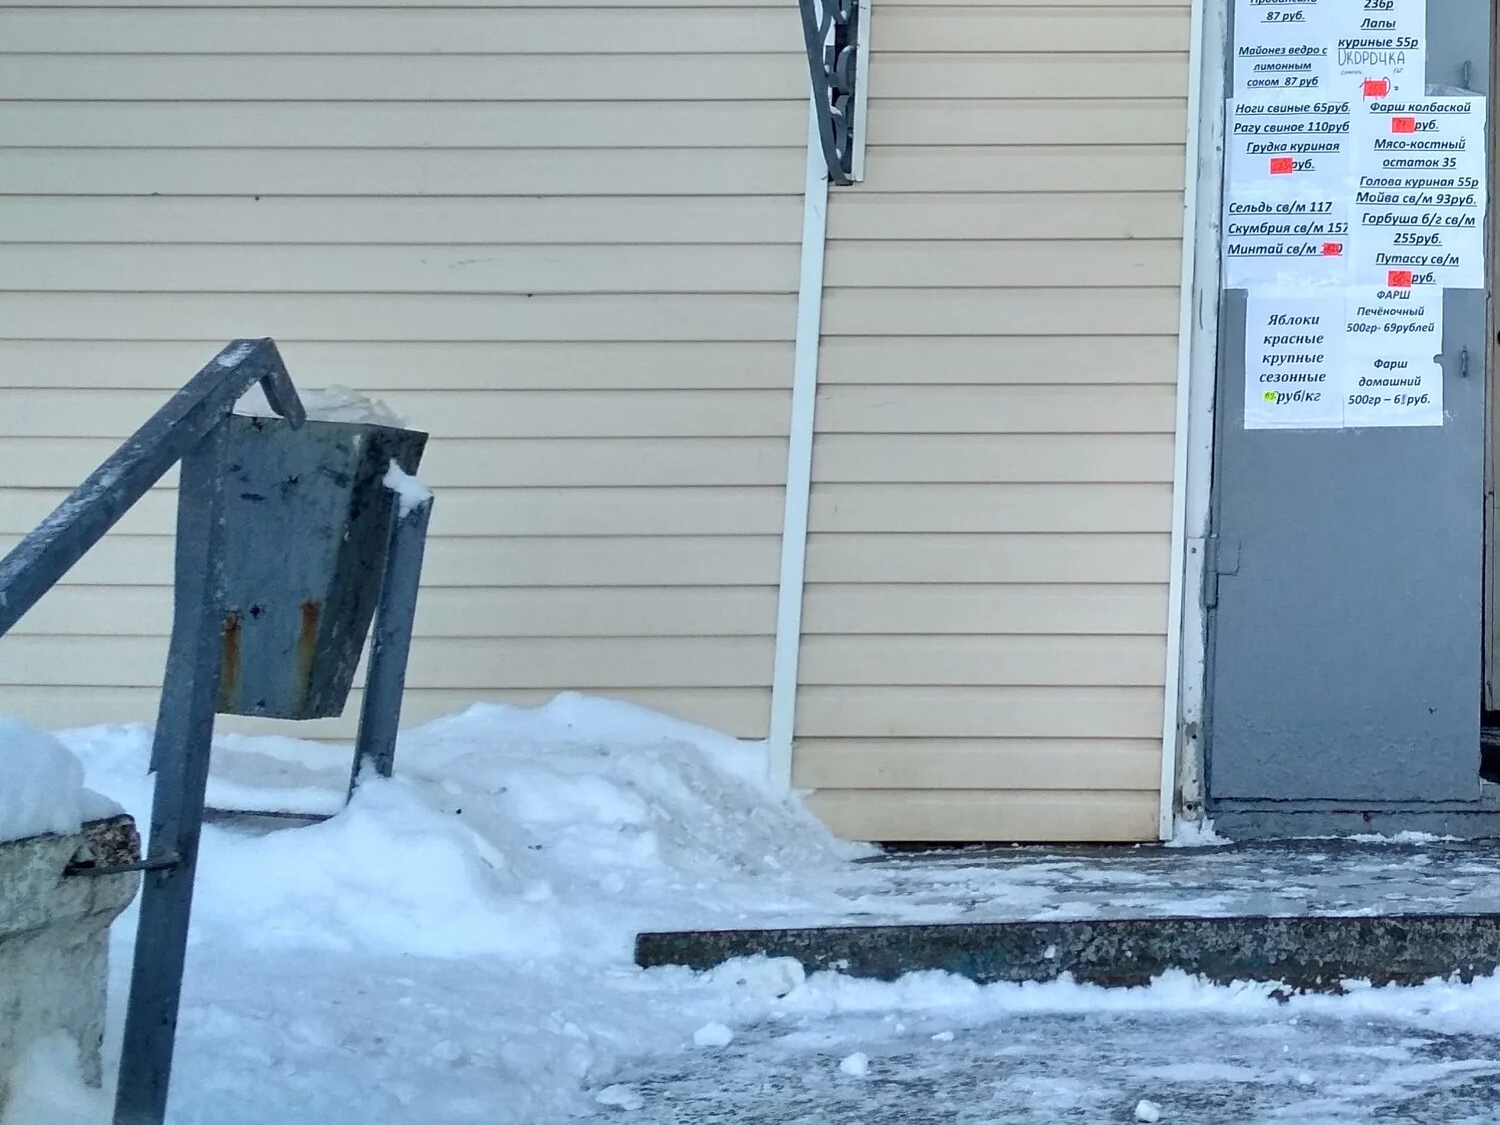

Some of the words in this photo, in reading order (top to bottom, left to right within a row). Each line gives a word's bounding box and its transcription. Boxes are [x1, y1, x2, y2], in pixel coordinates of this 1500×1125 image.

[1266, 12, 1281, 21] 87
[1282, 10, 1305, 22] руб.
[1360, 18, 1396, 28] Лапы
[1338, 38, 1393, 49] куриные
[1395, 36, 1419, 49] 55р
[1238, 45, 1286, 55] Майонез
[1288, 44, 1320, 55] ведро
[1322, 47, 1328, 55] с
[1253, 62, 1312, 71] лимонным
[1247, 78, 1280, 87] соком
[1284, 77, 1298, 86] 87
[1299, 76, 1319, 87] руб
[1235, 103, 1264, 113] Ноги
[1267, 104, 1310, 113] свиные
[1370, 102, 1405, 113] Фарш
[1408, 102, 1471, 112] колбаской
[1234, 122, 1261, 134] Рагу
[1263, 123, 1304, 132] свиное
[1307, 121, 1350, 133] 110руб
[1246, 141, 1287, 153] Грудка
[1290, 143, 1340, 153] куриная
[1374, 138, 1466, 149] Мясо-костный
[1382, 158, 1440, 167] остаток
[1442, 157, 1457, 167] 35
[1360, 176, 1402, 186] Голова
[1405, 178, 1454, 188] куриная
[1457, 177, 1479, 189] 55р
[1355, 191, 1400, 202] Мойва
[1402, 192, 1433, 205] св/м
[1436, 194, 1477, 206] 93руб.
[1229, 202, 1272, 213] Сельдь
[1276, 200, 1306, 214] св/м
[1309, 202, 1332, 212] 117
[1362, 212, 1418, 225] Горбуша
[1421, 212, 1442, 226] б/г
[1445, 213, 1476, 227] св/м
[1228, 222, 1290, 235] Скумбрия
[1293, 221, 1324, 235] св/м
[1393, 232, 1442, 245] 255руб.
[1227, 242, 1283, 254] Минтай
[1286, 242, 1316, 255] св/м
[1375, 253, 1428, 265] Путассу
[1430, 253, 1459, 266] св/м
[1376, 290, 1411, 299] ФАРШ
[1357, 306, 1425, 316] Печёночный
[1267, 313, 1320, 325] Яблоки
[1384, 322, 1435, 334] 69рублей
[1263, 334, 1324, 347] красные
[1262, 354, 1324, 366] крупные
[1373, 359, 1408, 370] Фарш
[1259, 373, 1326, 383] сезонные
[1358, 376, 1422, 387] домашний
[1348, 394, 1381, 406] 500гр
